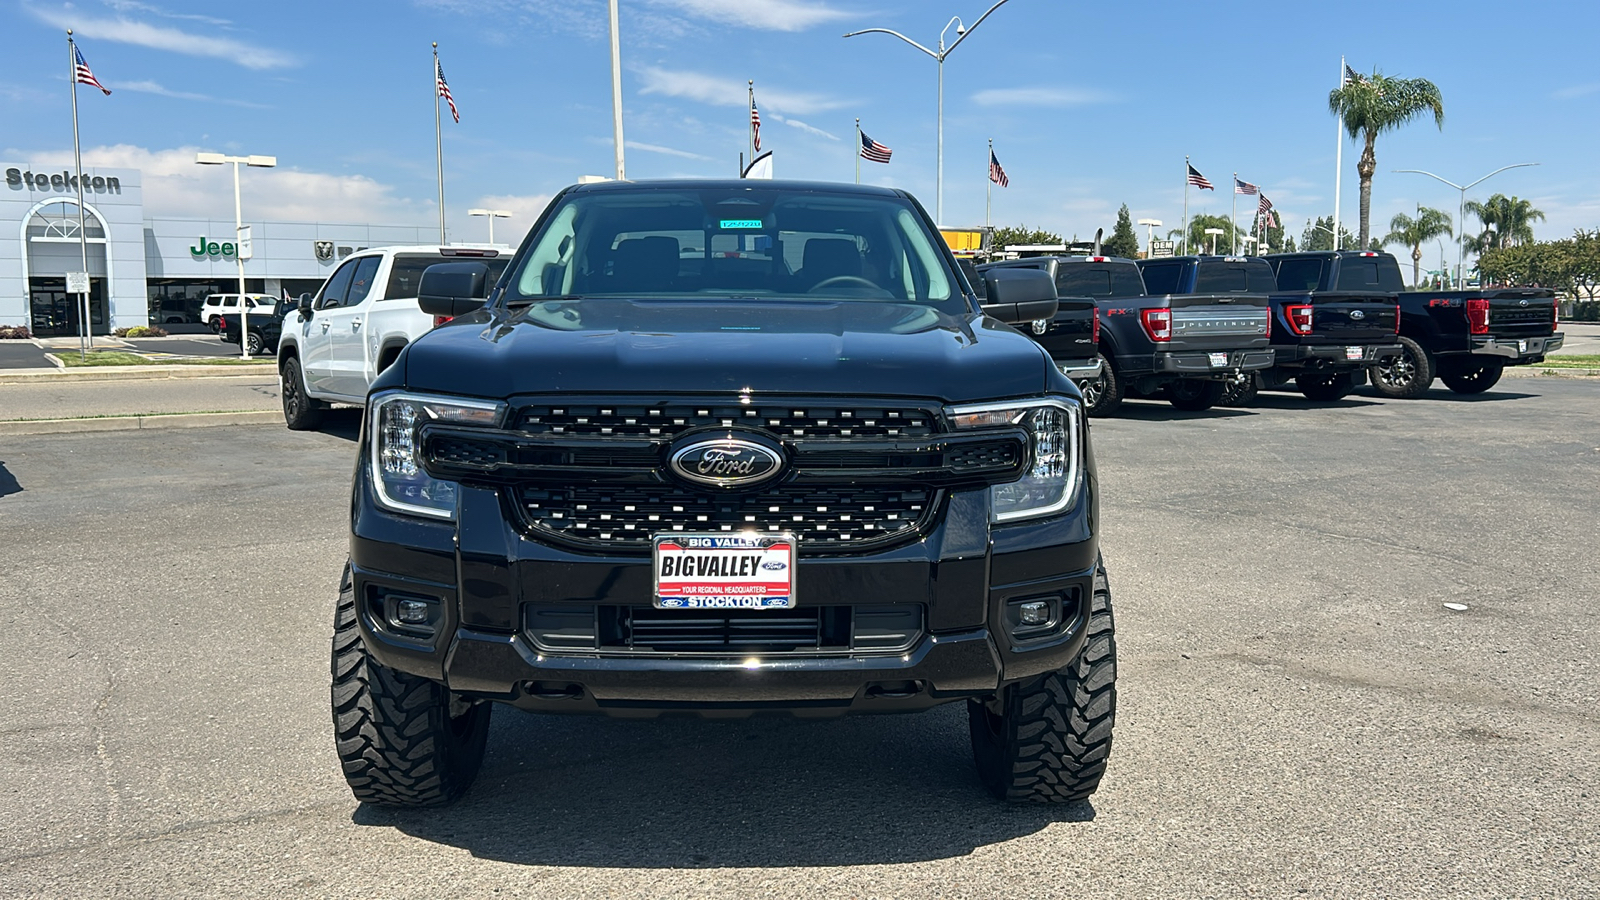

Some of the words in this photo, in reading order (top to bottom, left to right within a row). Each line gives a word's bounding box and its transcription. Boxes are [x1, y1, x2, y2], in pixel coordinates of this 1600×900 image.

[6, 168, 120, 189] Stockton
[1153, 241, 1173, 249] OEM
[1429, 299, 1462, 308] FX4
[1107, 308, 1135, 317] FX4
[697, 448, 756, 474] Ford
[689, 538, 712, 547] BIG
[714, 538, 761, 547] VALLEY
[682, 586, 697, 594] YOUR
[698, 586, 724, 594] REGIONAL
[725, 586, 767, 594] HEADQUARTERS
[688, 596, 762, 607] STOCKTON
